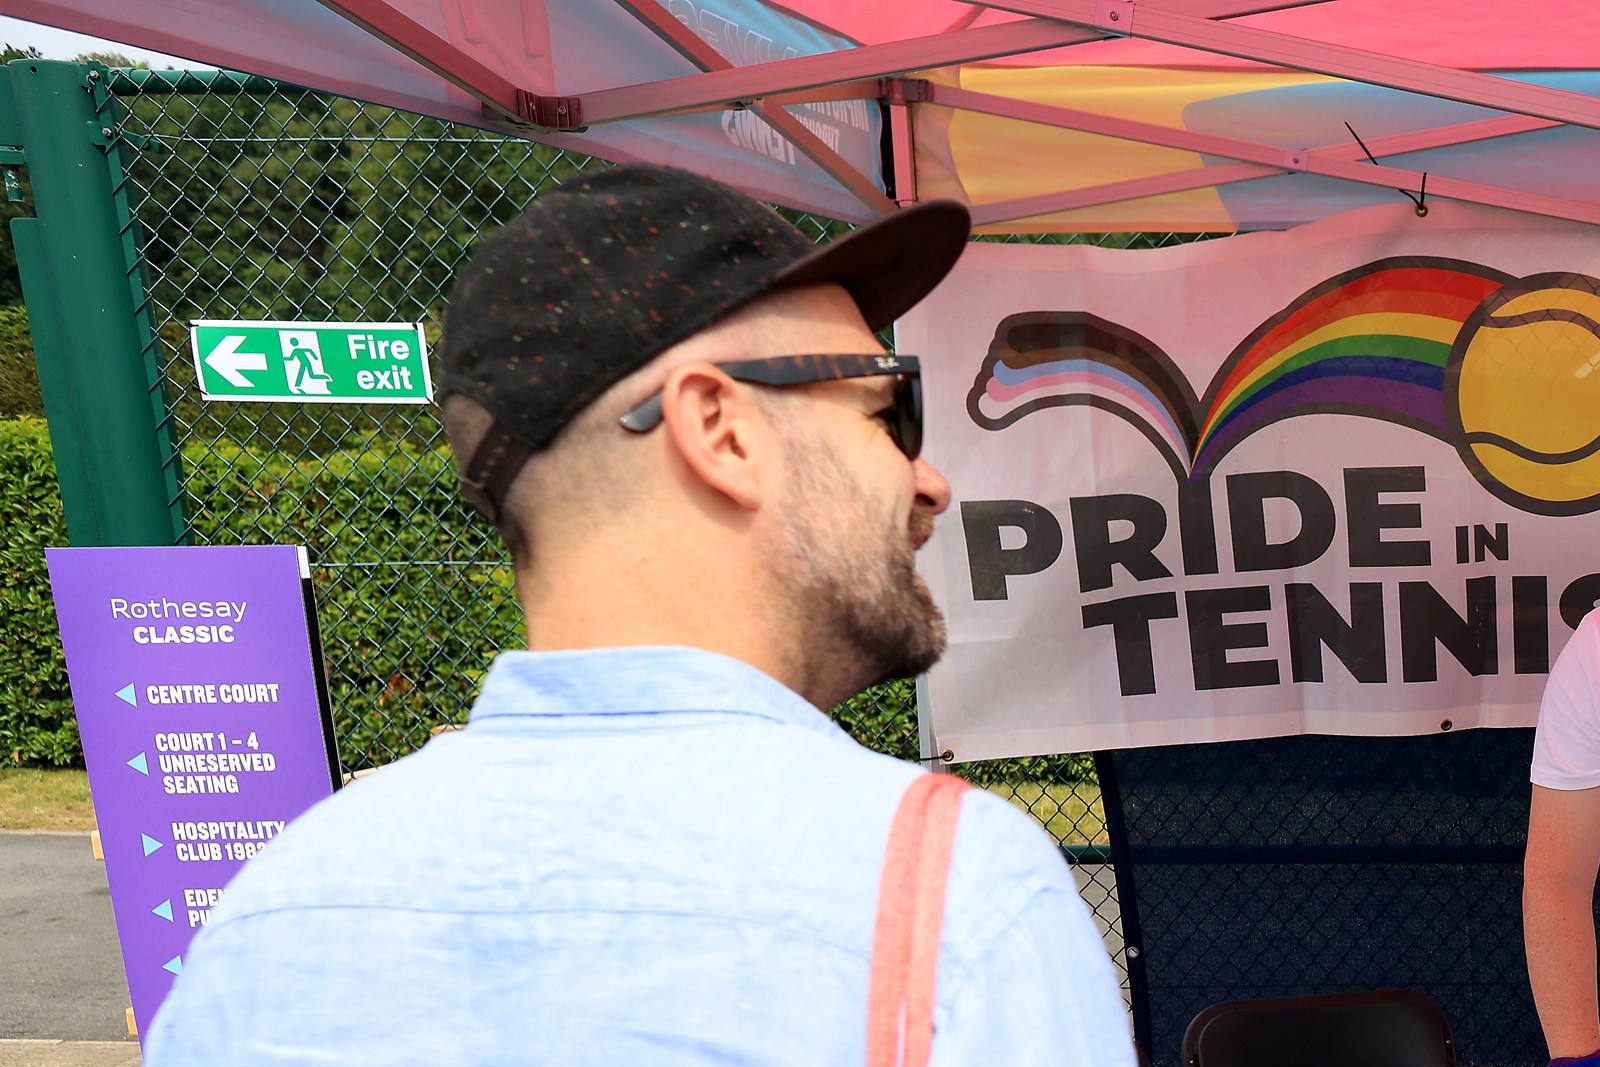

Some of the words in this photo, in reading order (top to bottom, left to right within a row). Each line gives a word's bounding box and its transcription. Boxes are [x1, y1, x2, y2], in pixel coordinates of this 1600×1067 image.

[347, 333, 411, 361] Fire
[356, 365, 413, 391] exit
[960, 466, 1432, 602] PRIDE
[1455, 523, 1510, 565] IN
[110, 597, 247, 623] Rothesay
[133, 625, 235, 644] CLASSIC
[146, 685, 218, 704] CENTRE
[219, 683, 279, 703] COURT
[155, 732, 214, 752] COURT
[218, 732, 227, 751] 1
[247, 731, 259, 750] 4
[158, 753, 277, 773] UNRESERVED
[163, 775, 240, 794] SEATING
[171, 820, 286, 841] HOSPITALITY
[176, 843, 222, 861] CLUB
